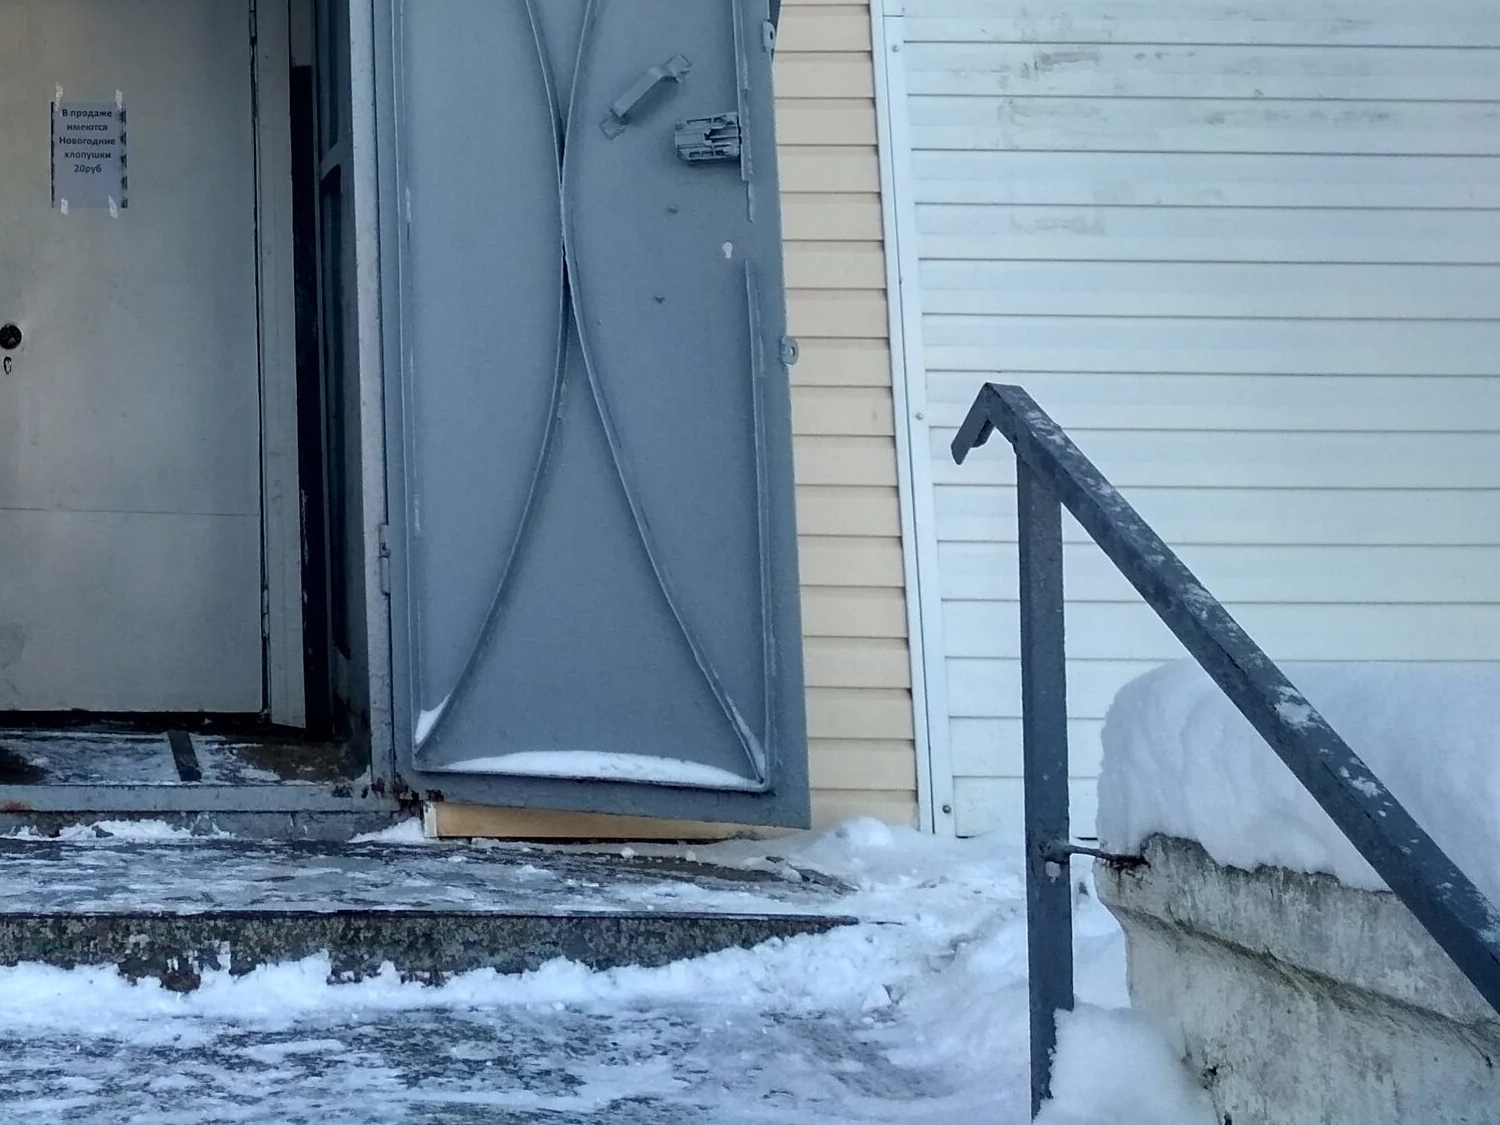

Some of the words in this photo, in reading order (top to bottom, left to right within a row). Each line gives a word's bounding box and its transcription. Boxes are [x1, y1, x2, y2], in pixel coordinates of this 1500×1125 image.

[62, 109, 68, 117] В
[70, 110, 112, 118] продаже
[59, 137, 116, 146] Новогодние
[64, 152, 111, 160] хлопушки
[74, 164, 102, 174] 20руб
